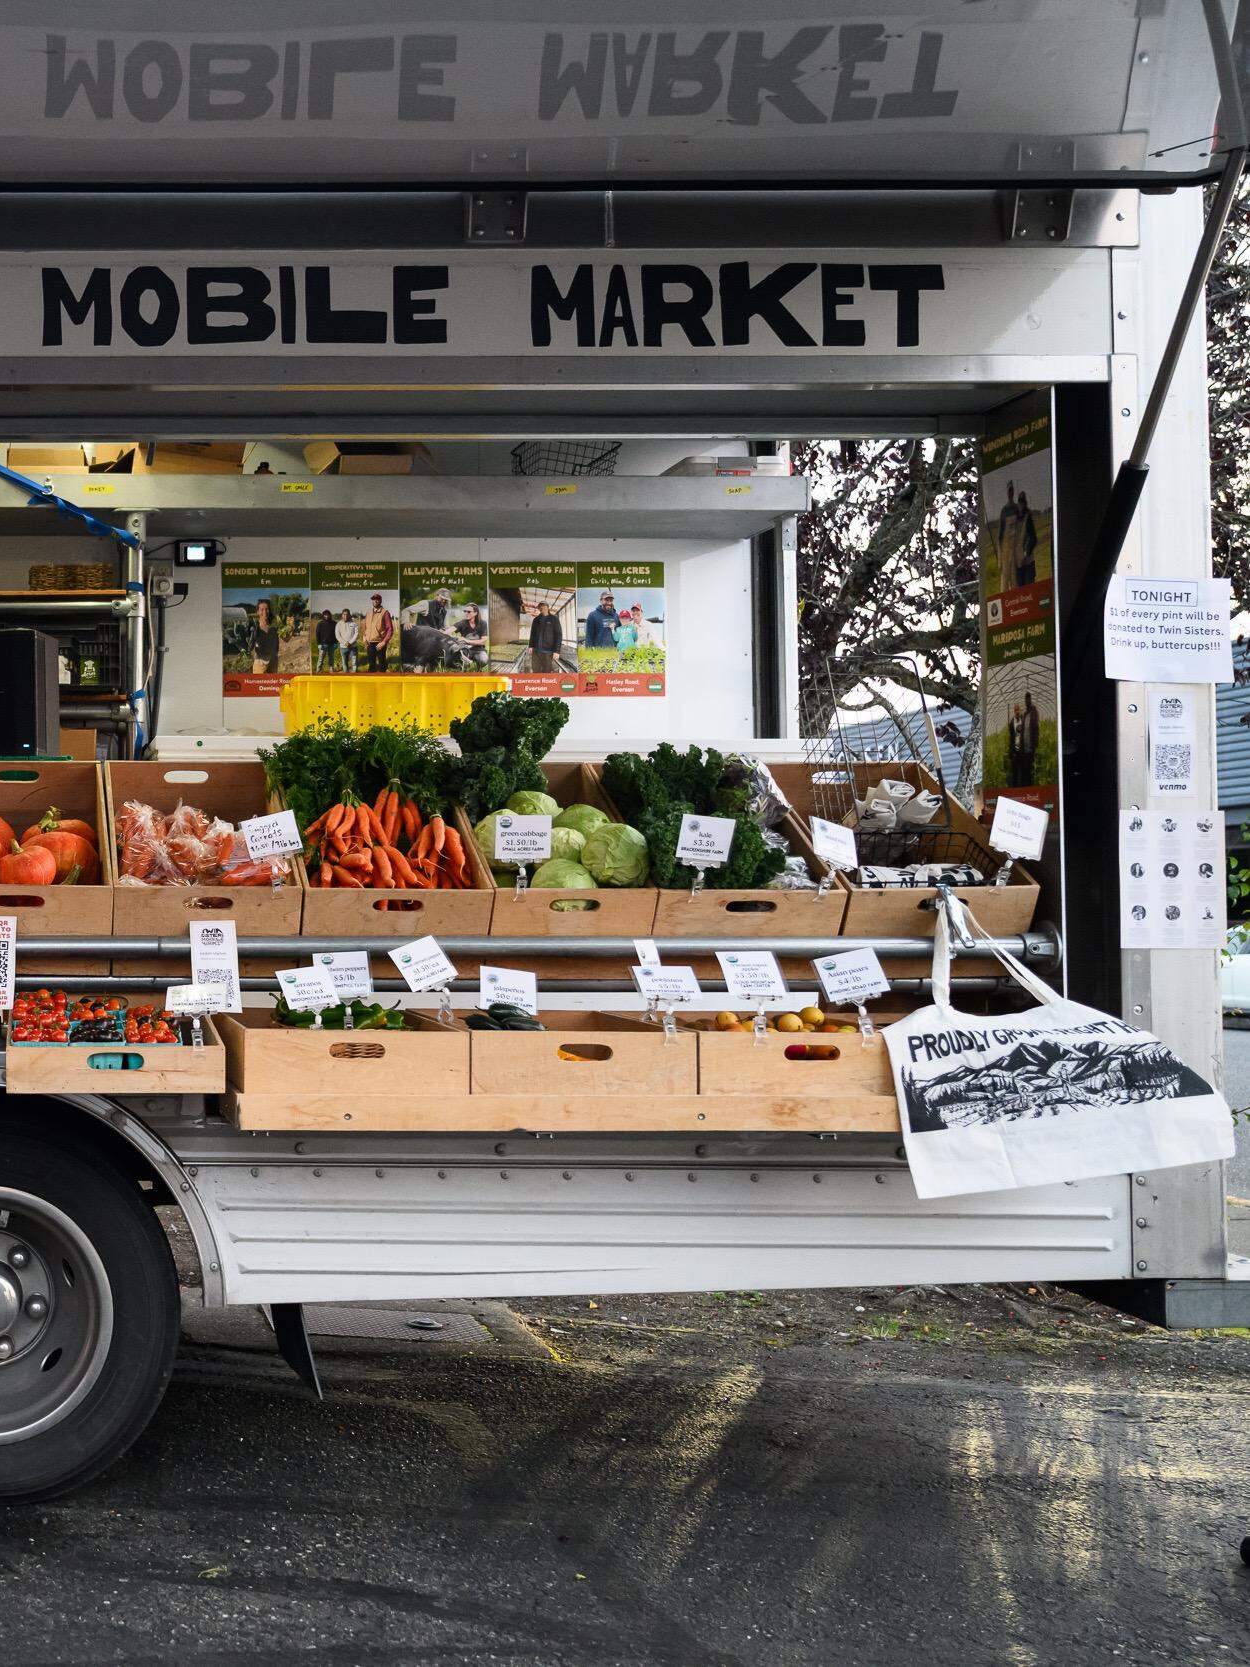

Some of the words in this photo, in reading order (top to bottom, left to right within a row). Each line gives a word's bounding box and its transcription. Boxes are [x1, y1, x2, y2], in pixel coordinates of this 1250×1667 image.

[42, 265, 449, 347] MOBILE
[531, 261, 945, 348] MARKET
[224, 567, 259, 576] SONDER
[261, 567, 307, 576] FARMSTEAD
[403, 566, 450, 576] ALLUVIAL
[453, 566, 483, 576] FARMS
[490, 566, 535, 575] VERTICAL
[536, 566, 552, 575] FOG
[554, 566, 575, 575] FARM
[591, 566, 619, 575] SMALL
[622, 566, 651, 575] ACRES
[1131, 590, 1192, 603] TONIGHT
[1110, 607, 1118, 616] $1
[1121, 608, 1130, 617] of
[1131, 611, 1159, 621] every
[1162, 610, 1183, 621] pint
[1186, 611, 1204, 621] will
[1206, 611, 1220, 621] be
[1026, 622, 1046, 637] FARM
[1108, 623, 1143, 634] donated
[1145, 625, 1155, 634] to
[1158, 625, 1182, 635] Twin
[1184, 626, 1224, 636] Sisters.
[1111, 637, 1132, 647] Drink
[1134, 641, 1149, 649] up,
[1151, 640, 1221, 652] buttercups!!!
[519, 830, 548, 838] cabbage
[698, 831, 712, 839] kale
[693, 839, 715, 848] $3.50
[907, 1029, 989, 1062] PROUDLY
